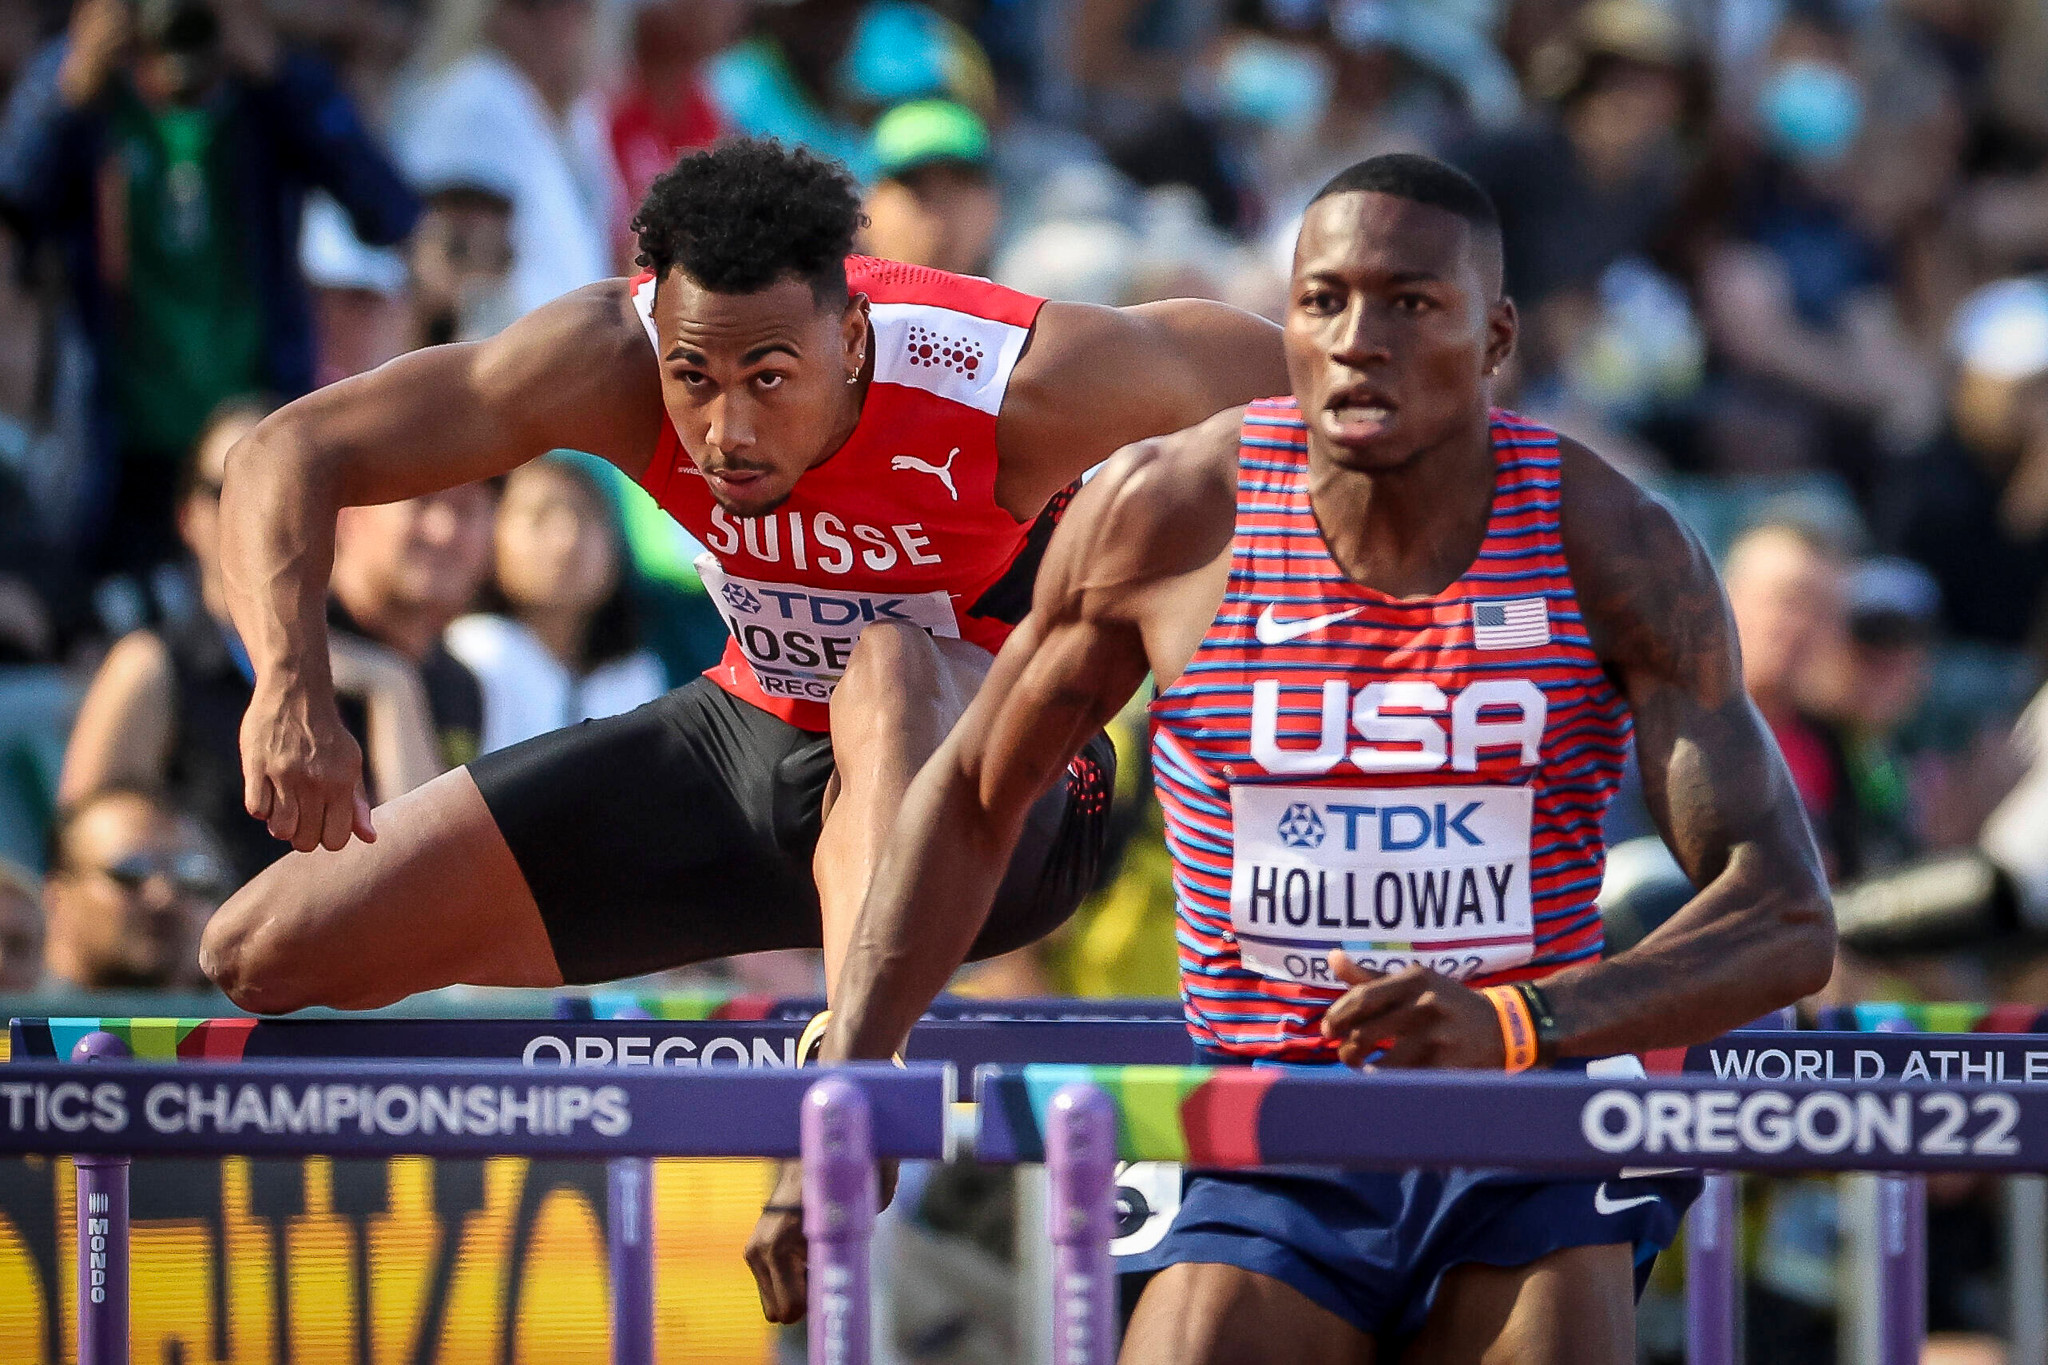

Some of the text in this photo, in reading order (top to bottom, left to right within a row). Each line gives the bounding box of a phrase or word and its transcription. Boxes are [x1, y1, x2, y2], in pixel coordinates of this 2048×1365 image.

[706, 503, 942, 574] SUISSE
[759, 588, 912, 627] TDK
[729, 614, 934, 671] JOSE
[1250, 678, 1548, 775] USA
[1326, 801, 1485, 851] TDK
[1249, 863, 1515, 930] HOLLOWAY
[1710, 1049, 2048, 1084] WORLD ATHLE
[2, 1083, 632, 1138] TICS CHAMPIONSHIPS
[1581, 1089, 2022, 1156] OREGON22
[88, 1217, 109, 1304] MONDO
